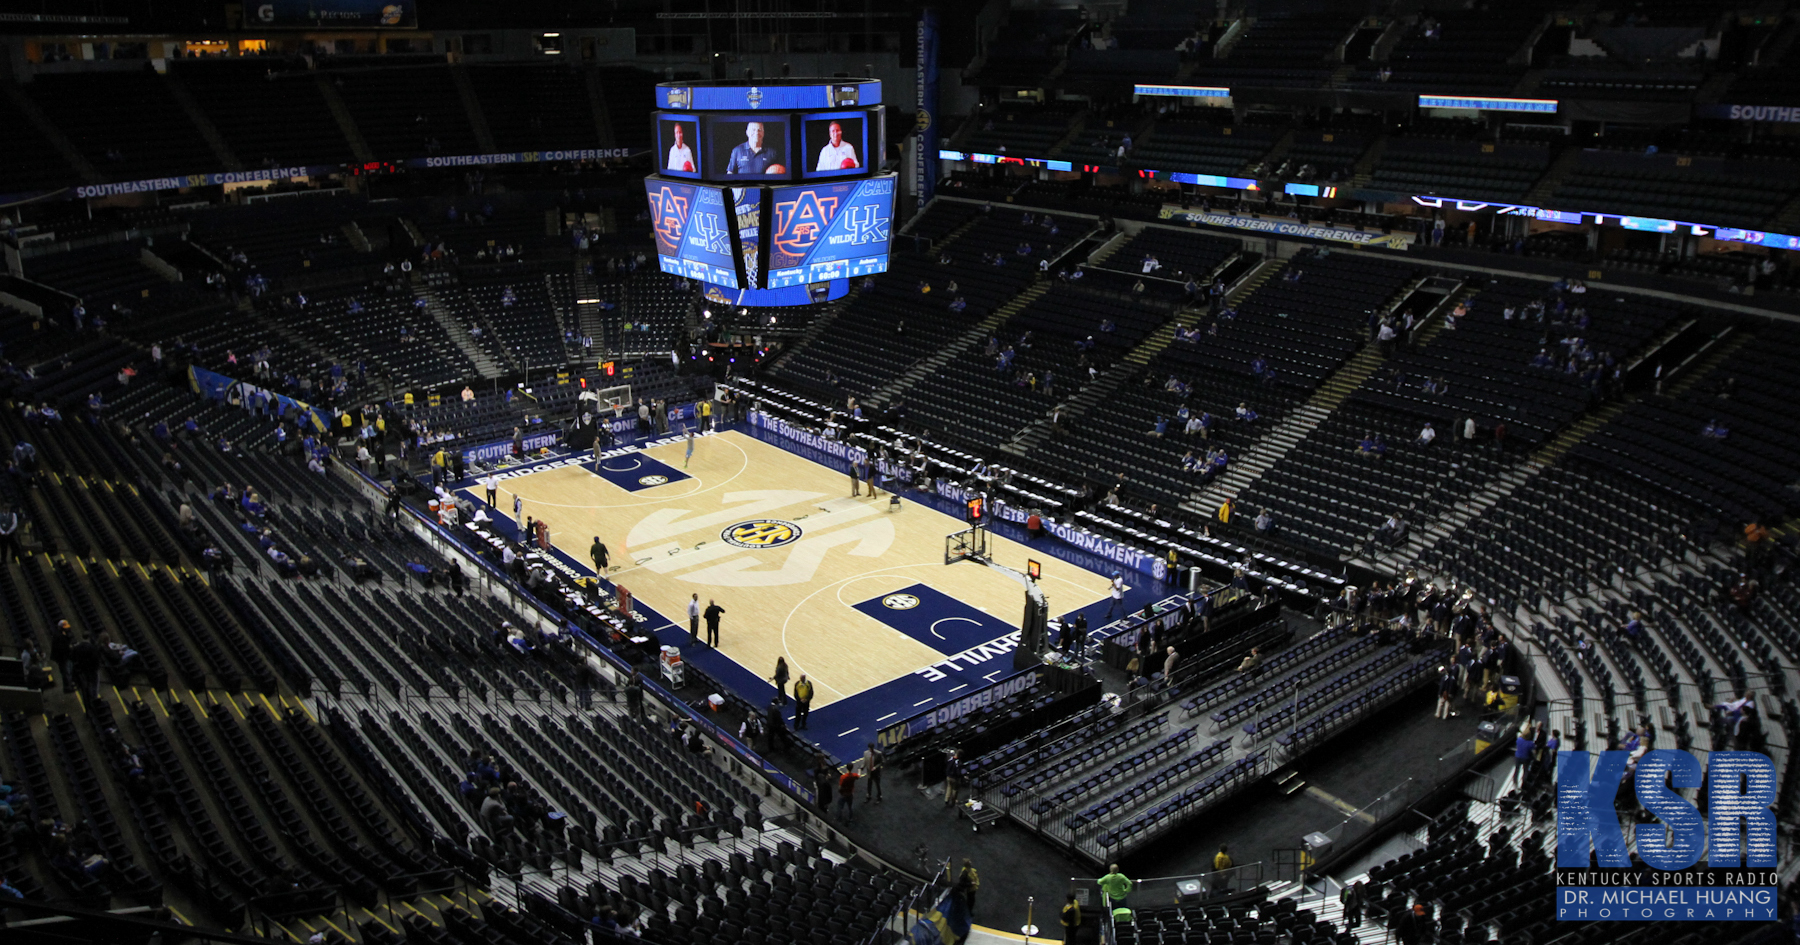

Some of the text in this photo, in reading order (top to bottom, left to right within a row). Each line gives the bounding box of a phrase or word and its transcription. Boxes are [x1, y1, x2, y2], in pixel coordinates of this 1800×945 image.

[917, 20, 925, 106] SOUTHEASTERN
[426, 153, 516, 168] SOUTHEASTERN
[545, 148, 629, 162] CONFERENCE
[77, 176, 179, 199] SOUTHEASTERN
[214, 166, 307, 184] CONFERENCE
[1186, 212, 1276, 231] SOUTHEASTERN
[1279, 224, 1372, 244] CONFERENCE
[819, 270, 840, 280] 60:00
[468, 433, 557, 462] SOUTHESTERN
[762, 416, 778, 432] THE
[779, 421, 846, 458] SOUTHEASTERN
[1049, 522, 1143, 569] TOURNAMENT
